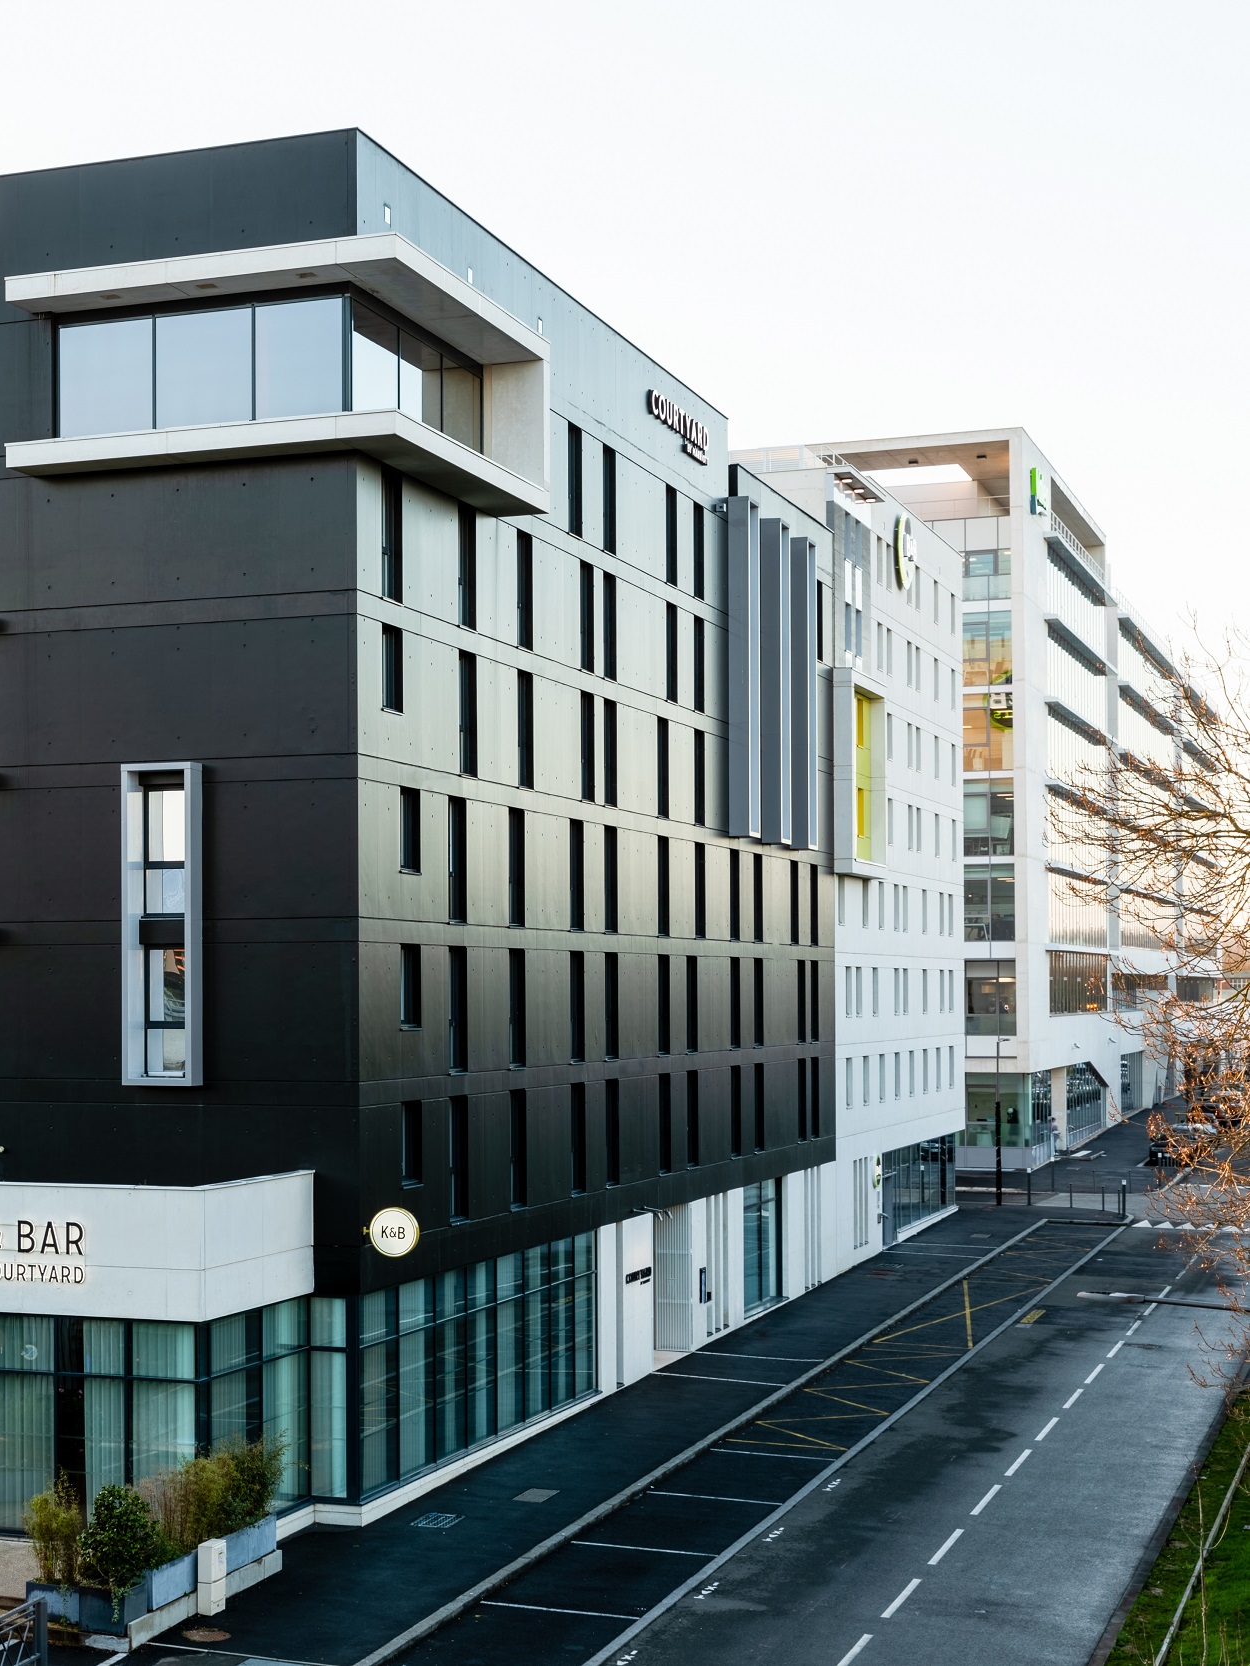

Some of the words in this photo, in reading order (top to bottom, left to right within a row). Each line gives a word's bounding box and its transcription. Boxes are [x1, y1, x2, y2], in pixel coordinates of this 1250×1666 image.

[652, 389, 709, 452] COURTYARD
[17, 1219, 85, 1256] BAR
[381, 1225, 406, 1240] K&B
